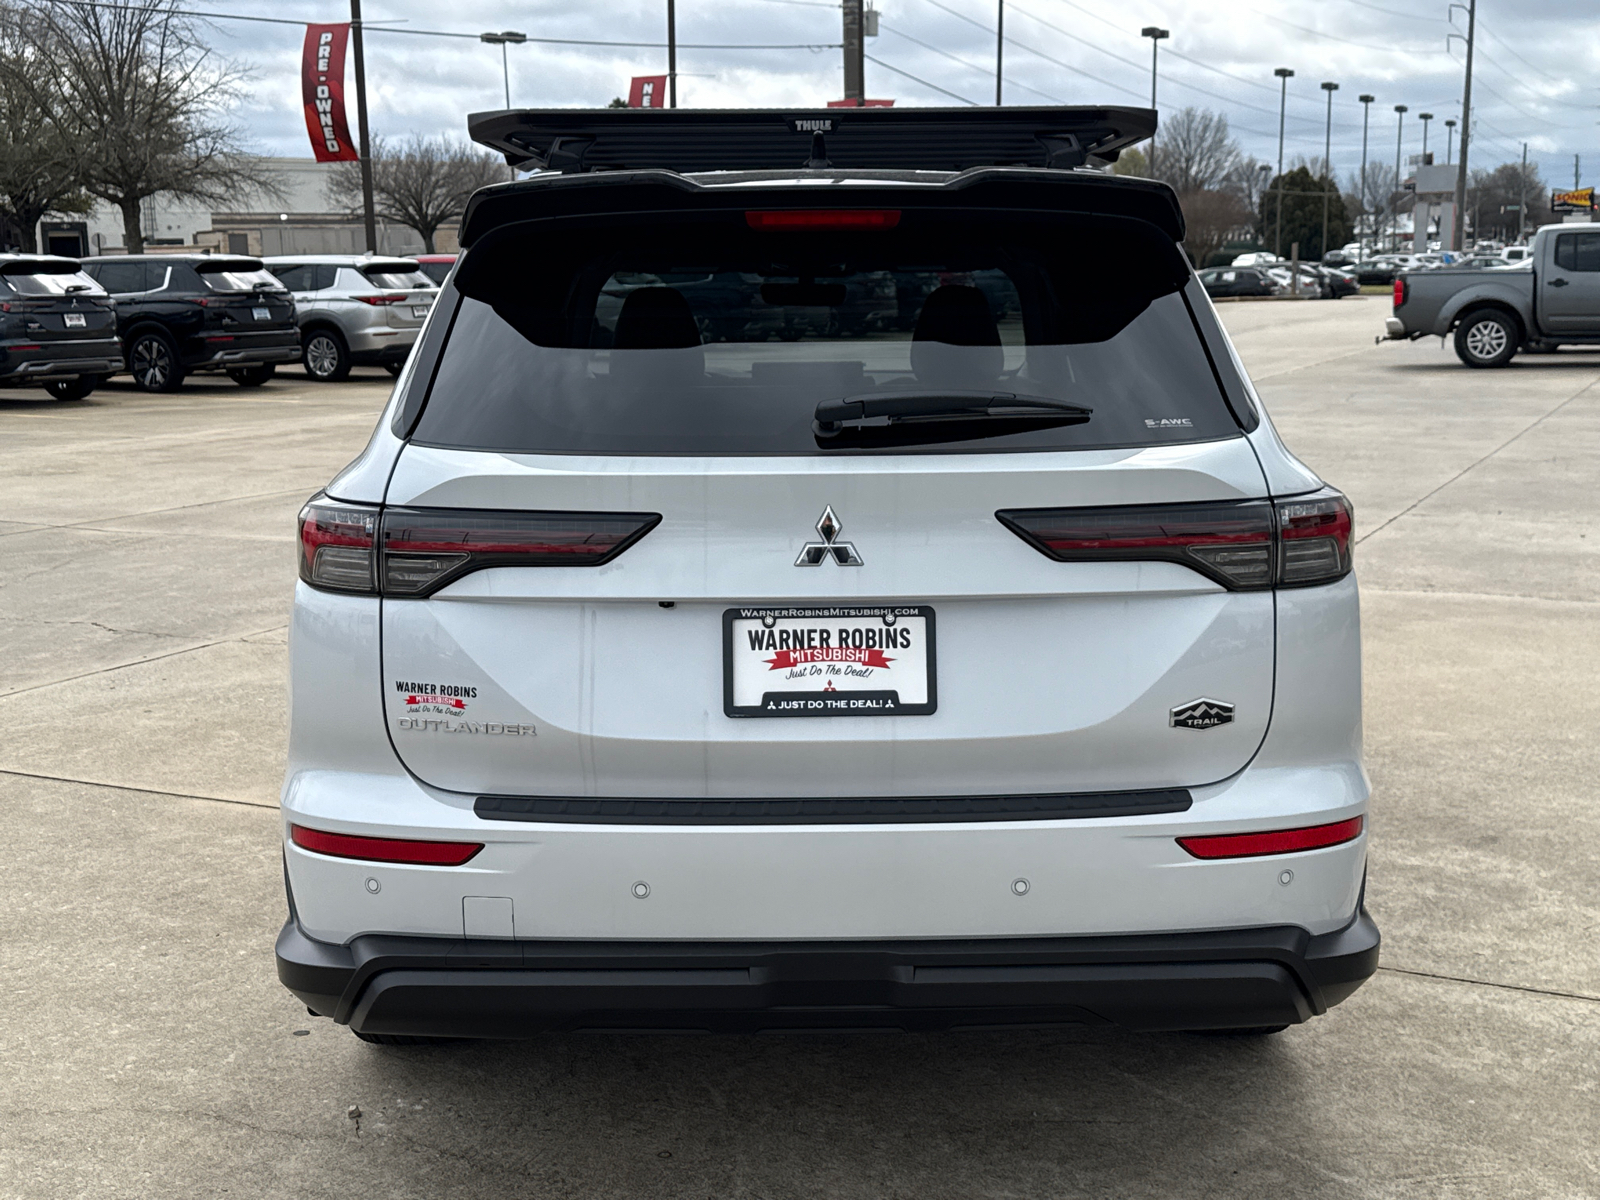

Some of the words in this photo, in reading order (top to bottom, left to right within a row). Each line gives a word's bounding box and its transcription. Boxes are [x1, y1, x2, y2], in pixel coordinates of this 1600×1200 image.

[315, 31, 341, 154] PRE-OWNED
[795, 120, 832, 130] THULE
[1555, 192, 1590, 202] SONIC
[1144, 418, 1192, 426] S-AWC
[747, 629, 831, 651] WARNER
[837, 627, 911, 649] ROBINS
[789, 648, 869, 663] MITSUBISHI
[785, 668, 807, 680] Just
[809, 665, 822, 675] Do
[825, 664, 842, 676] The
[844, 665, 873, 679] Deal!
[395, 681, 437, 695] WARNER
[440, 684, 478, 698] ROBINS
[415, 696, 456, 706] MITSUBISHI
[778, 700, 805, 709] JUST
[807, 700, 824, 709] DO
[826, 699, 848, 708] THE
[850, 699, 883, 708] DEAL!
[407, 706, 421, 714] Just
[432, 706, 443, 714] The
[445, 708, 465, 717] Deal!
[397, 717, 537, 736] OUTLANDER
